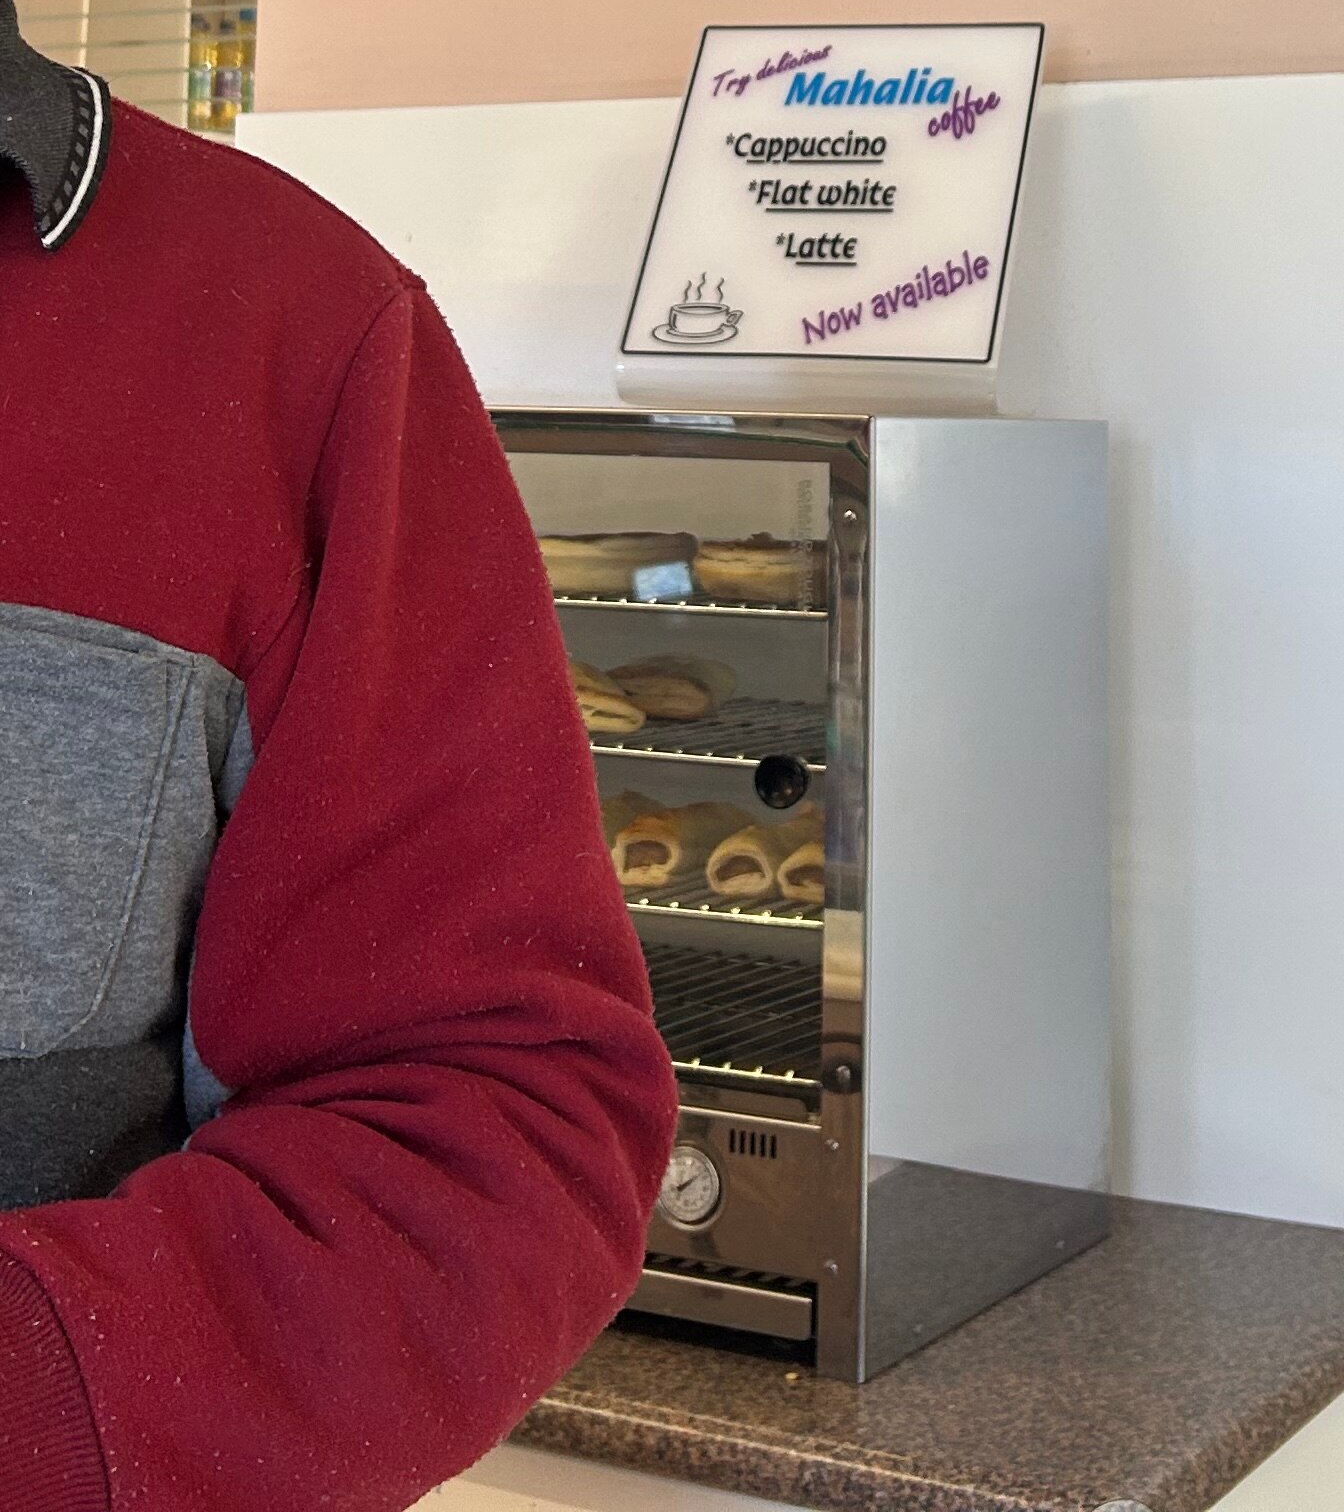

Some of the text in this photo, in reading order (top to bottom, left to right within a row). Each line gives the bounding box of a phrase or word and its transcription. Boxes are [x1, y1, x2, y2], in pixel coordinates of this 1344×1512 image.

[712, 44, 833, 97] Try delicious
[783, 67, 956, 107] Mahalia
[927, 86, 1001, 139] coffee
[816, 178, 897, 207] white
[801, 249, 990, 344] Now available
